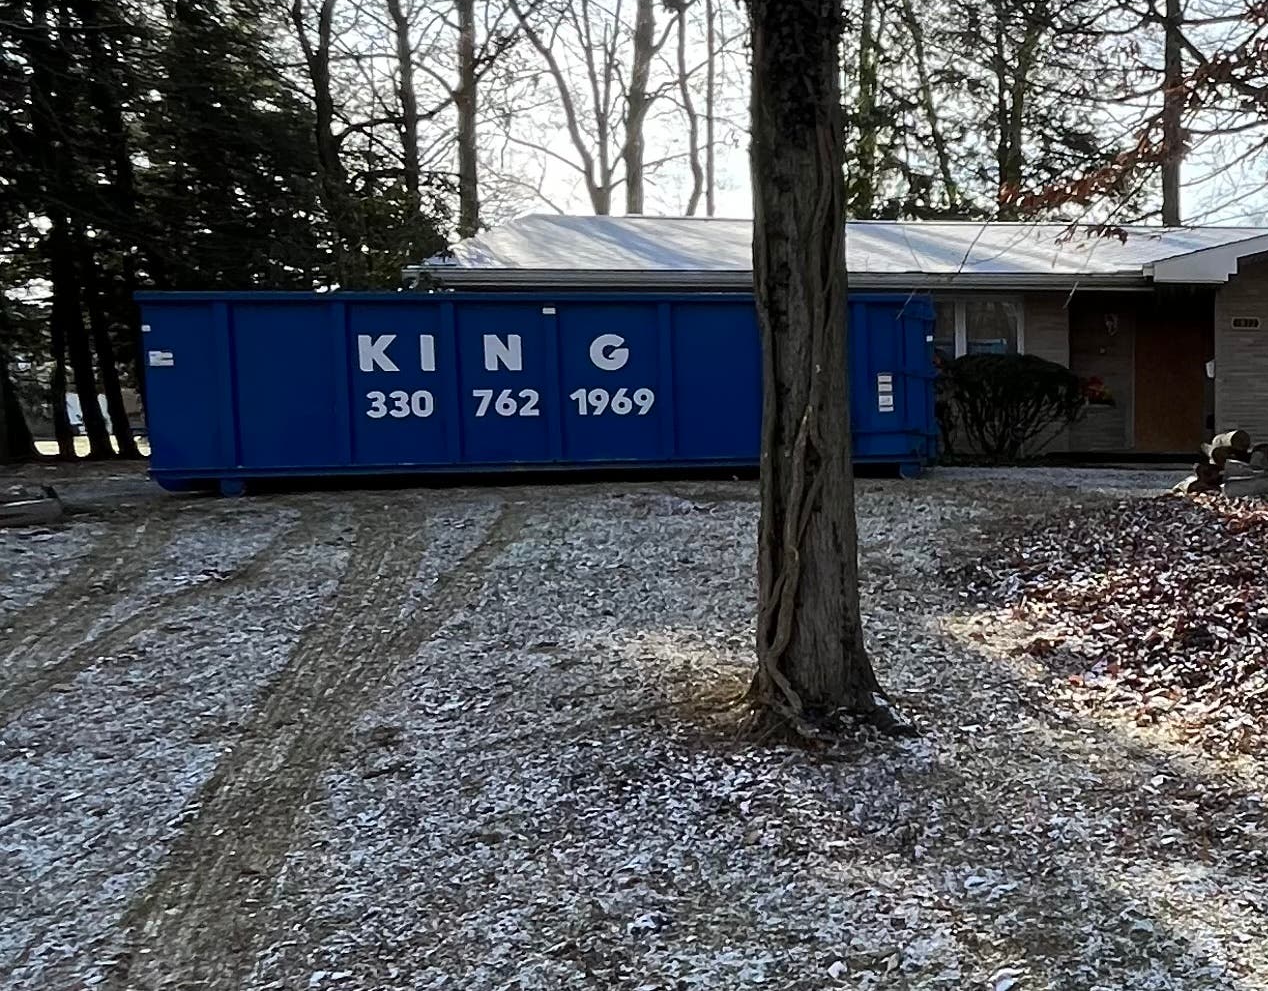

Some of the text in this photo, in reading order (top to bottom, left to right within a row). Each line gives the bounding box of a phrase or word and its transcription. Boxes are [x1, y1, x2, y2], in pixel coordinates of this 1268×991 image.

[366, 387, 655, 418] 330 762 1969
